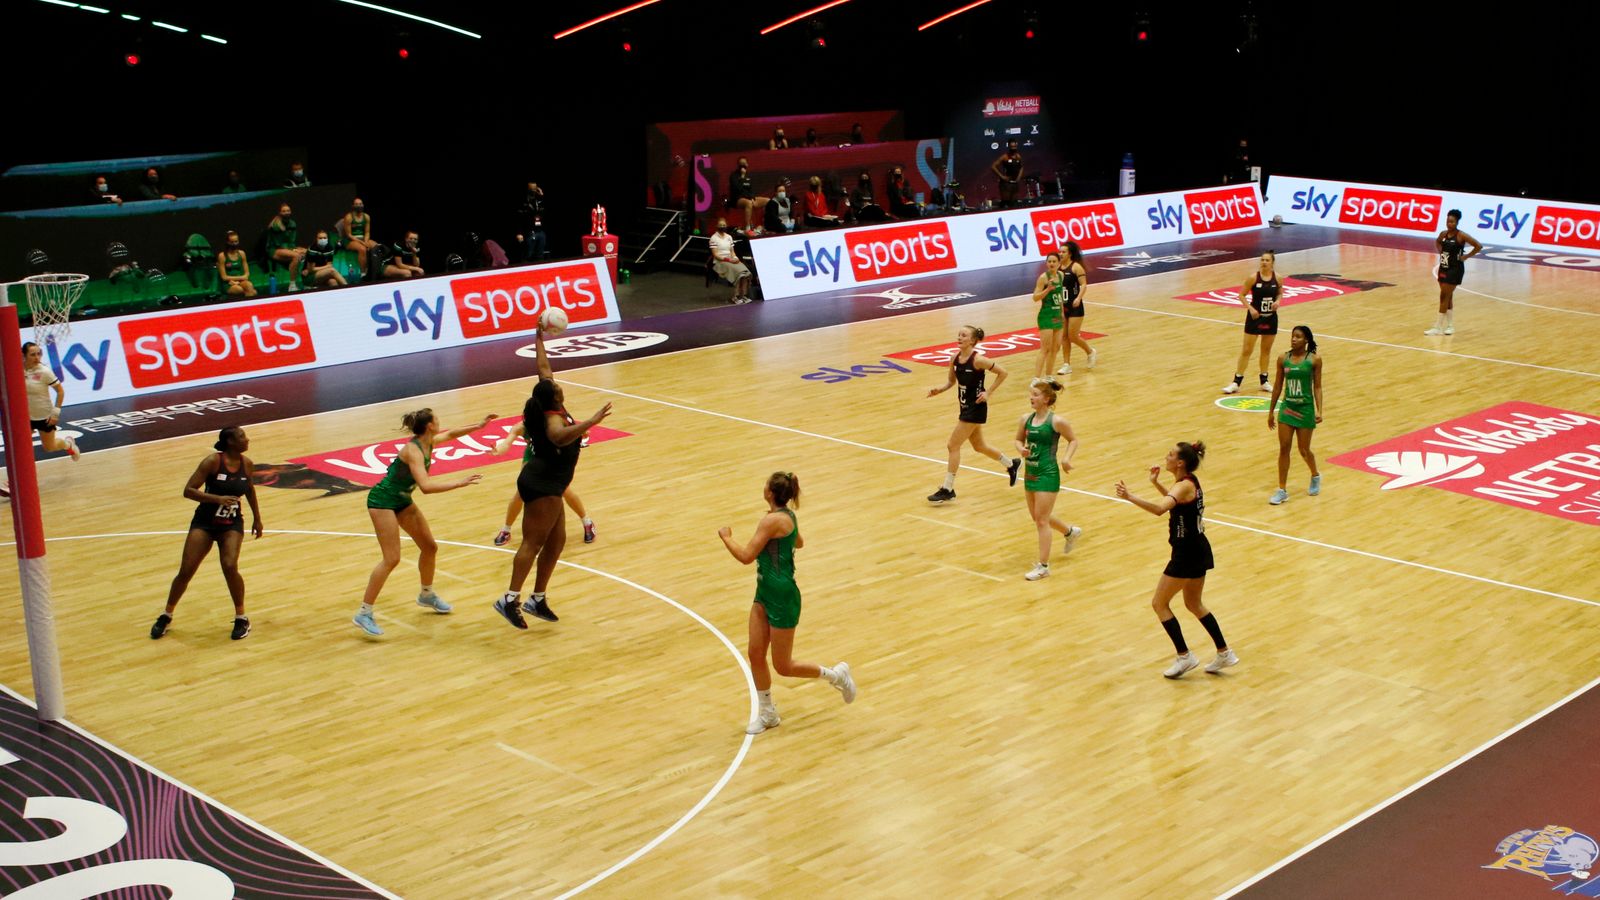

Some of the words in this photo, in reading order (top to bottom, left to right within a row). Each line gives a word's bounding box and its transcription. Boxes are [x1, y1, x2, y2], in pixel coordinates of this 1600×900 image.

[1015, 98, 1039, 107] NETBALL
[1147, 199, 1183, 235] sky
[1190, 194, 1256, 230] sports
[1290, 186, 1338, 219] sky
[1345, 195, 1435, 222] sports
[1477, 203, 1531, 238] sky
[1538, 215, 1600, 242] spo
[985, 217, 1029, 257] sky
[1038, 211, 1117, 250] sports
[788, 239, 842, 283] sky
[853, 230, 949, 274] sports
[370, 290, 446, 340] sky
[463, 275, 596, 329] sports
[46, 334, 111, 391] ky
[134, 315, 302, 377] sports
[801, 360, 913, 384] sky
[912, 333, 1041, 363] sort
[1287, 379, 1304, 397] WA
[66, 393, 258, 427] PERFORM
[1423, 412, 1600, 455] Vitality
[1472, 444, 1600, 506] NETB
